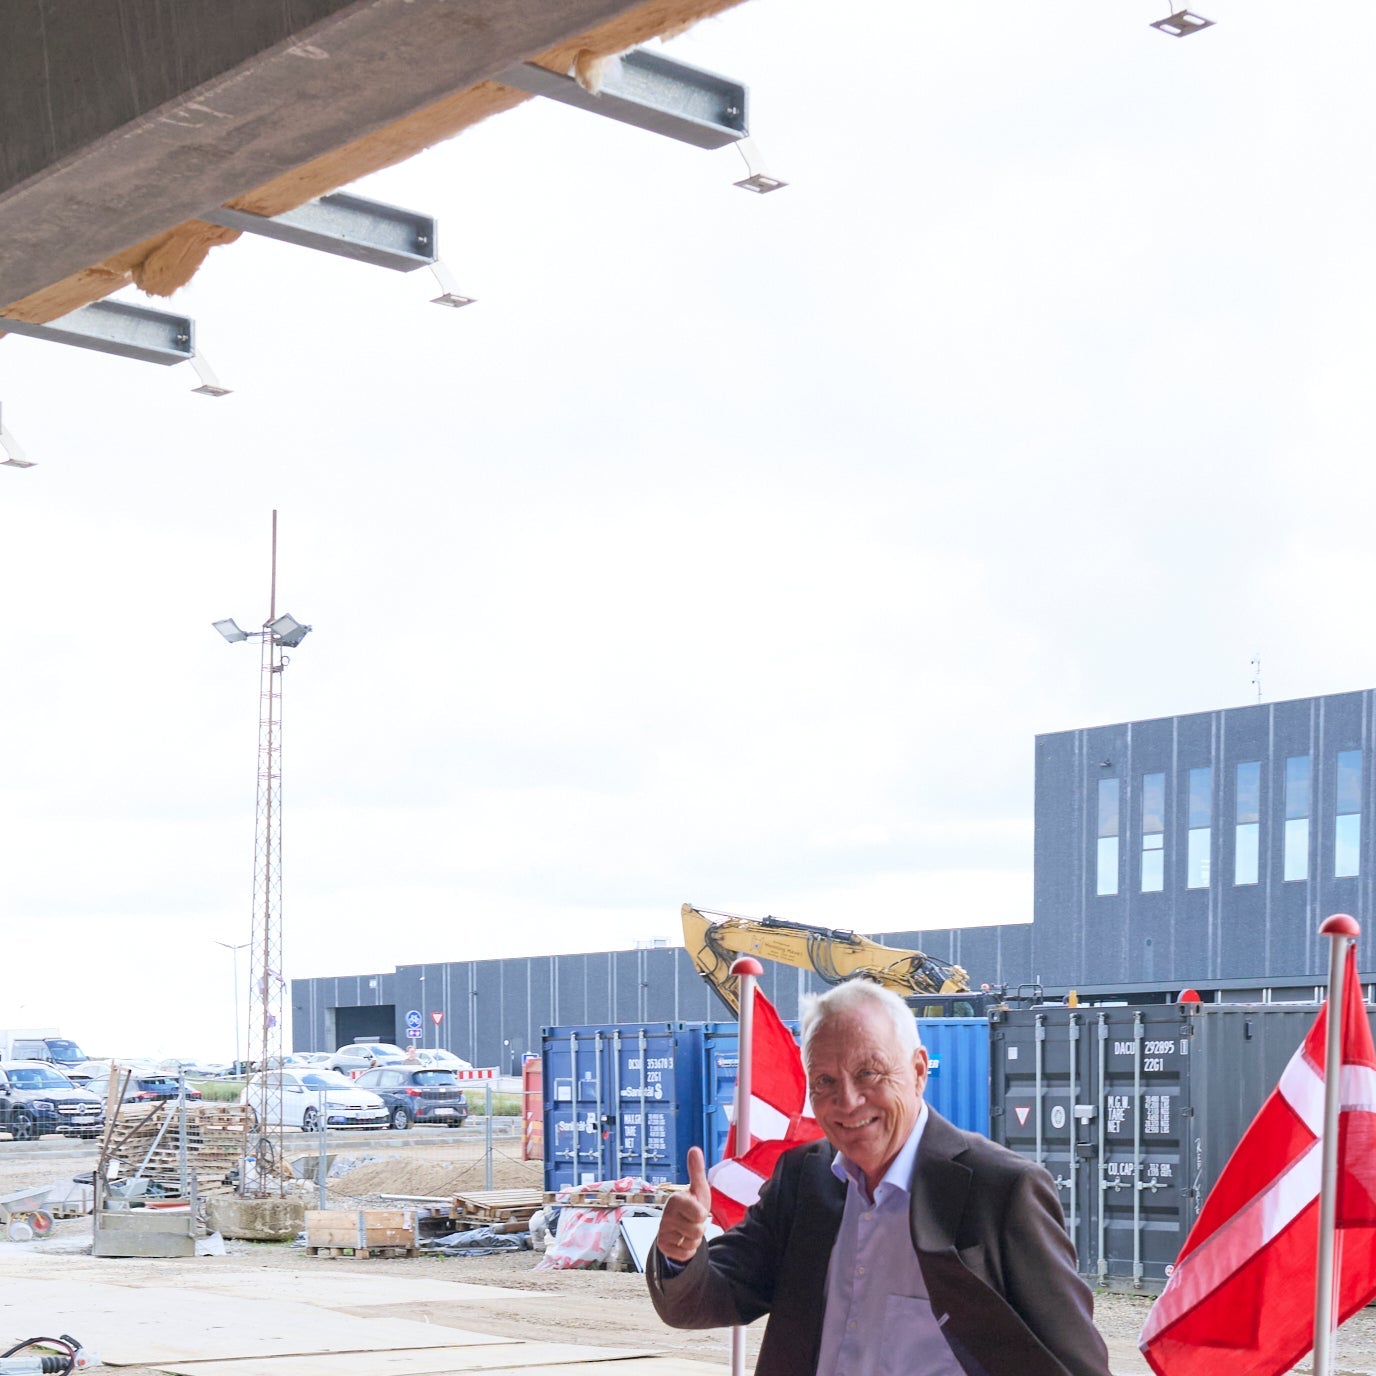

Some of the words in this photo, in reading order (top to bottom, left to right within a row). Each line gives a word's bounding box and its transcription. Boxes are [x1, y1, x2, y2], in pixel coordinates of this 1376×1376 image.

[1114, 1042, 1135, 1055] DACU
[1144, 1040, 1174, 1054] 292895
[1144, 1058, 1163, 1071] 22G1
[626, 1086, 654, 1097] Sanitål
[1108, 1108, 1125, 1121] TARE
[1107, 1120, 1121, 1133] NET
